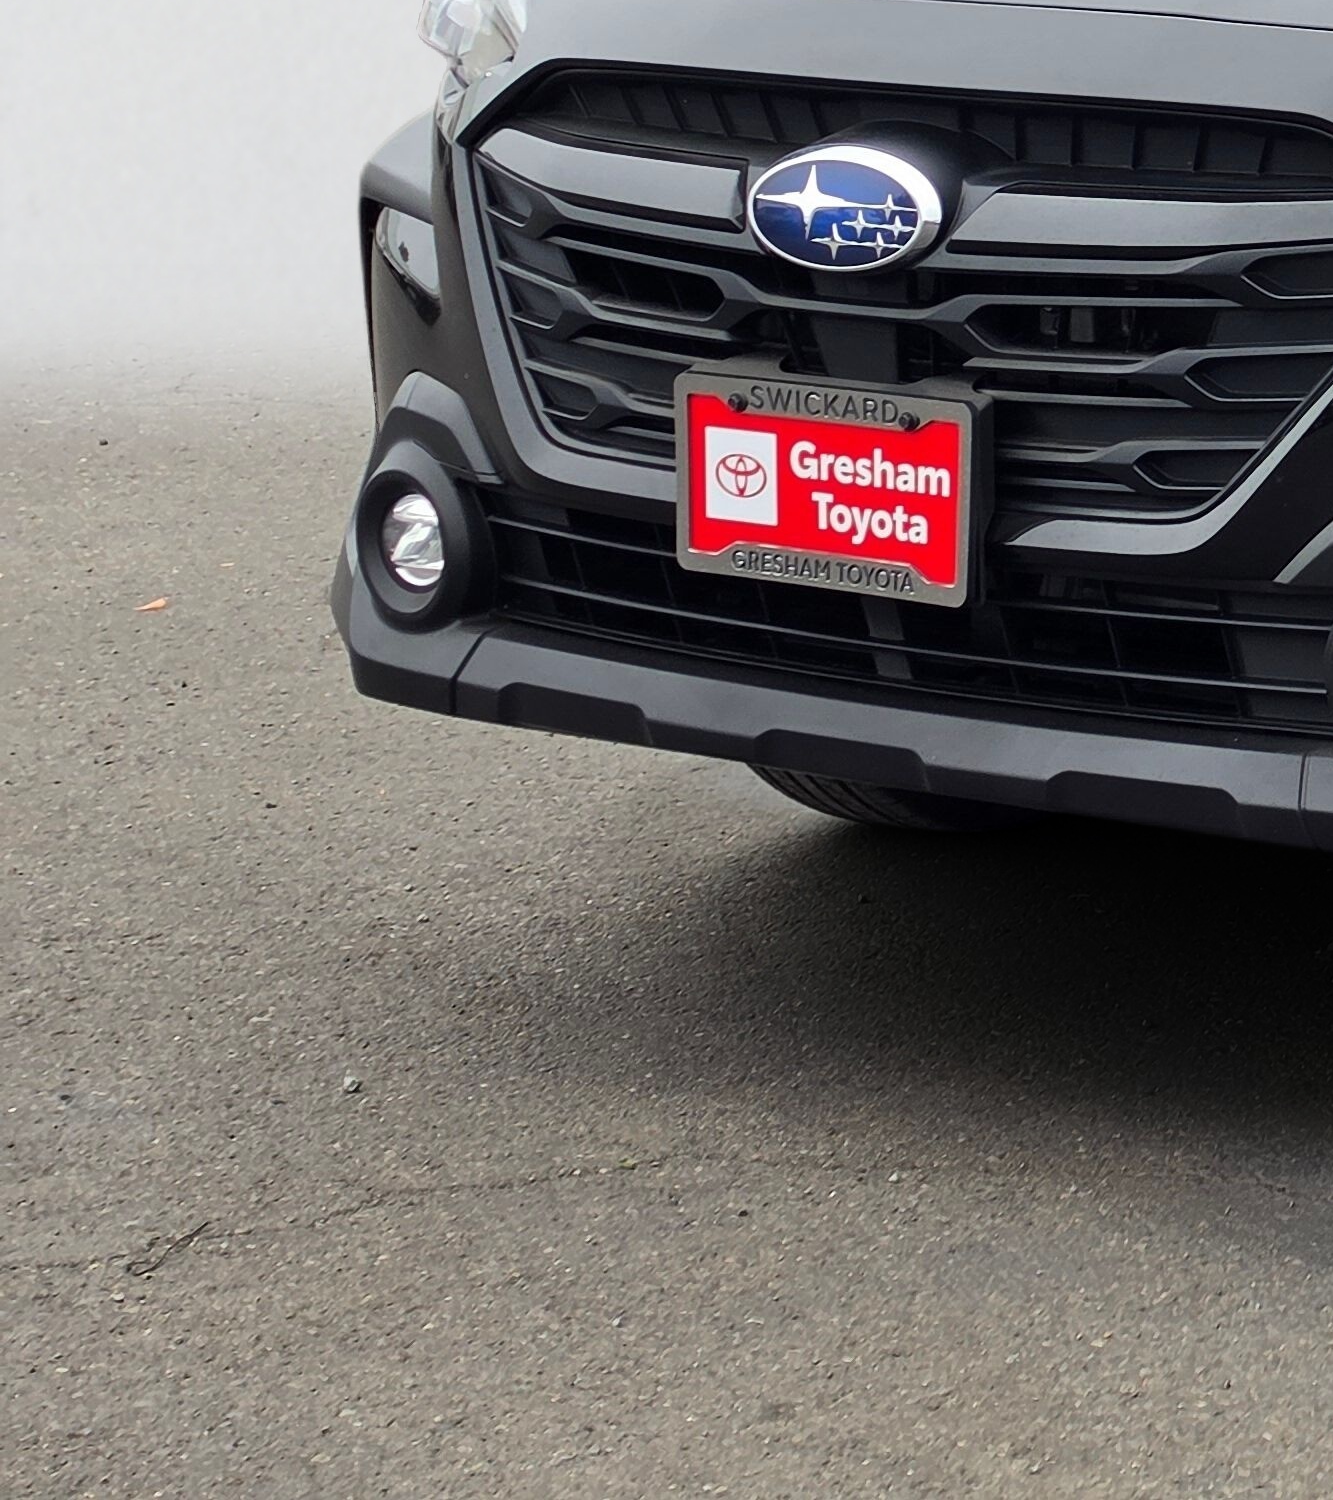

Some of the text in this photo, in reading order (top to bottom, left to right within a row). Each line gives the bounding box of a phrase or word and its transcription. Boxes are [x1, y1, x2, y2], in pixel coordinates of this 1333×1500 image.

[750, 385, 899, 425] SWICKARD
[789, 440, 951, 498] Gresham
[811, 491, 929, 545] Toyota
[731, 549, 915, 596] GRESHAM TOYOTA
